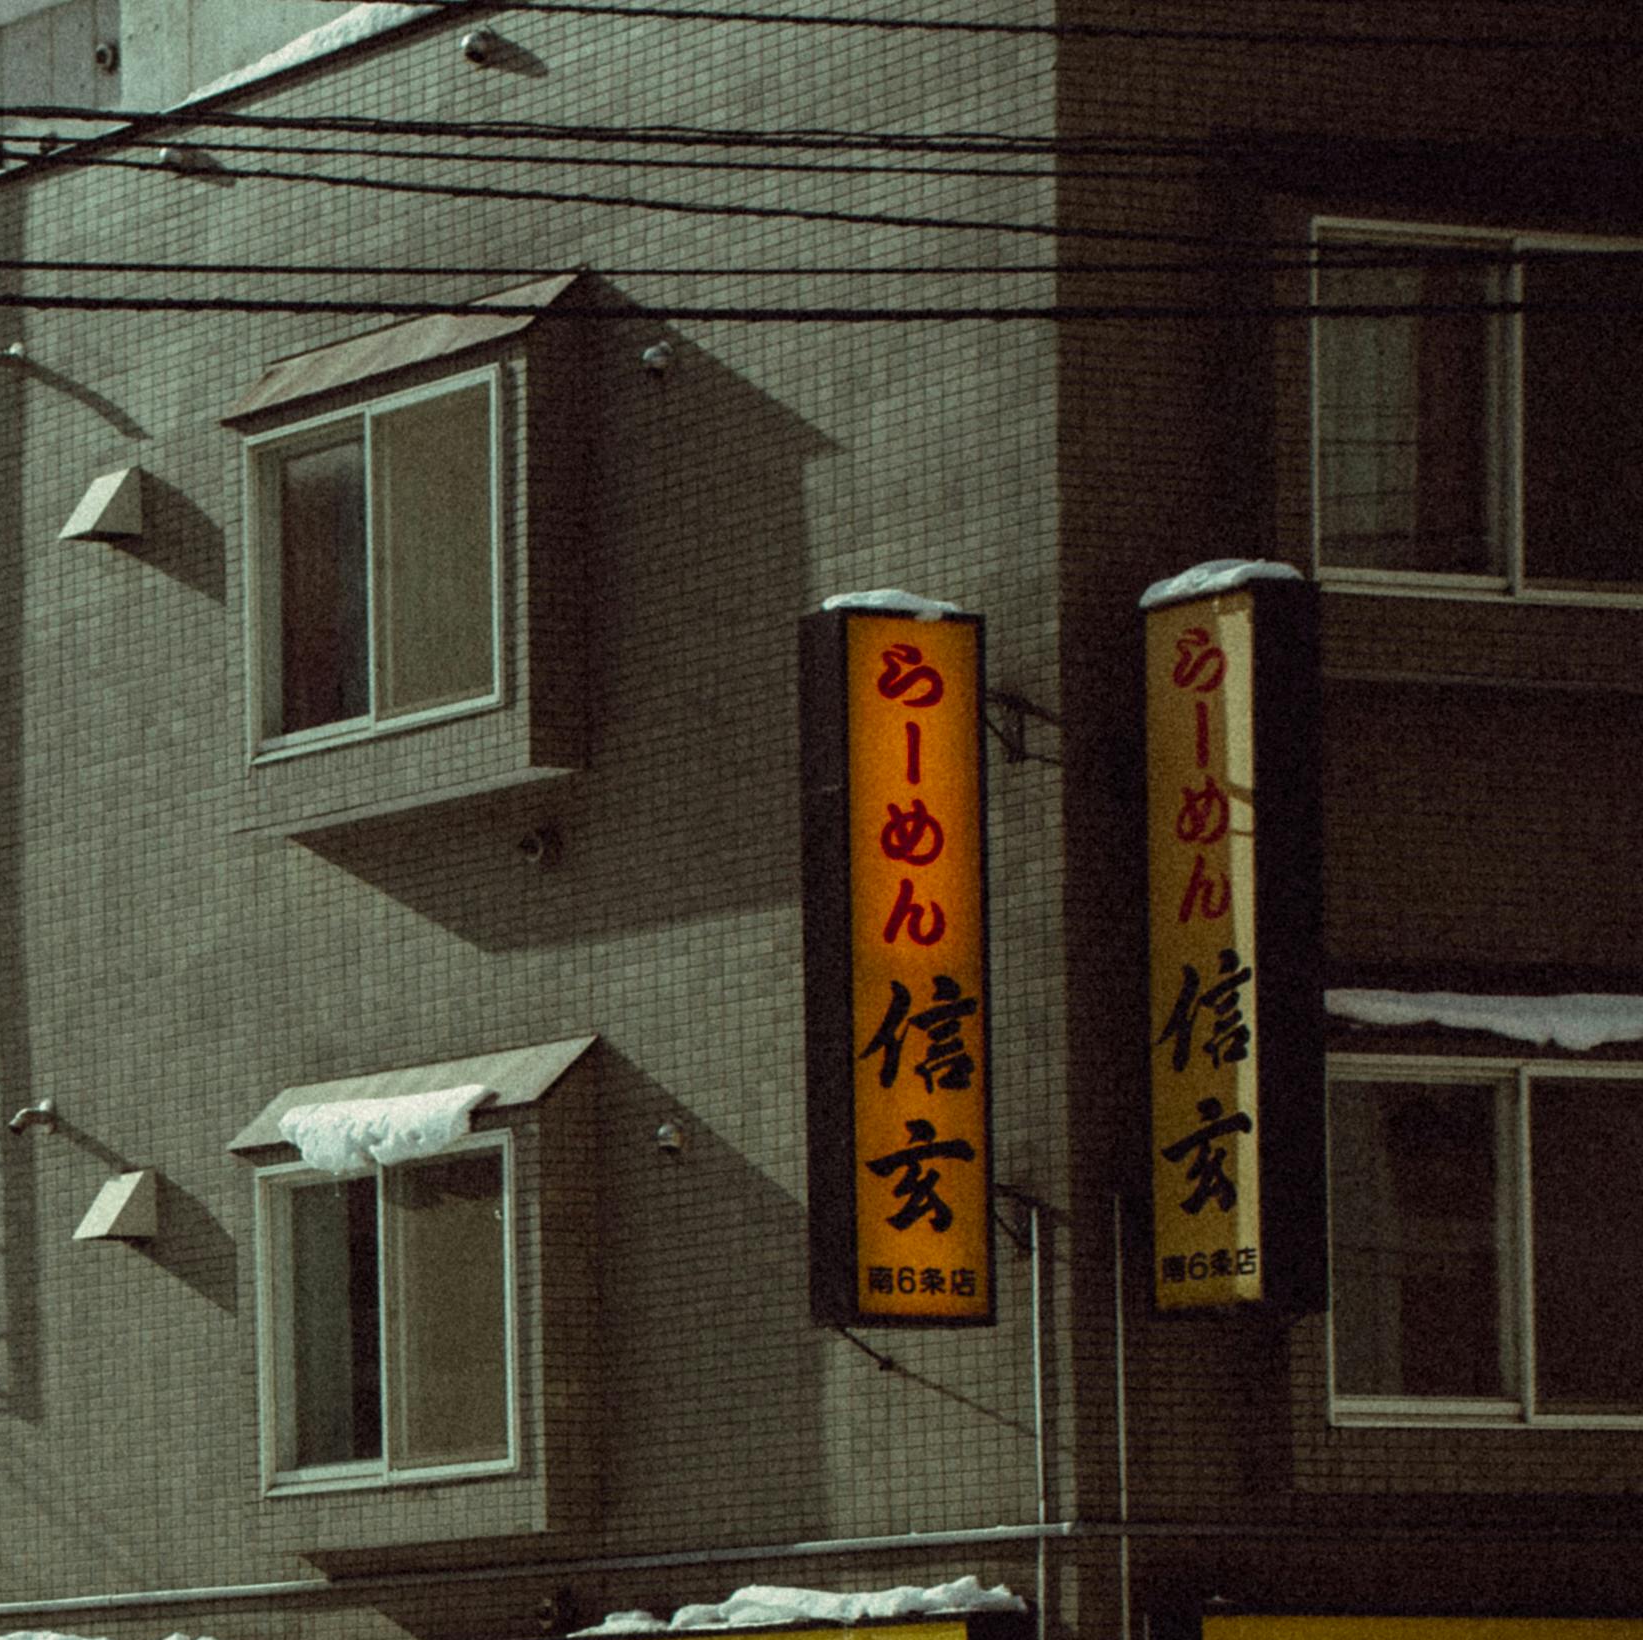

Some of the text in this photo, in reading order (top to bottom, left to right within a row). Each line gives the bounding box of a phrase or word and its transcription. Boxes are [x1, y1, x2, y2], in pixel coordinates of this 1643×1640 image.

[866, 1265, 977, 1298] 南6条店
[1162, 1246, 1258, 1284] 南6条店
